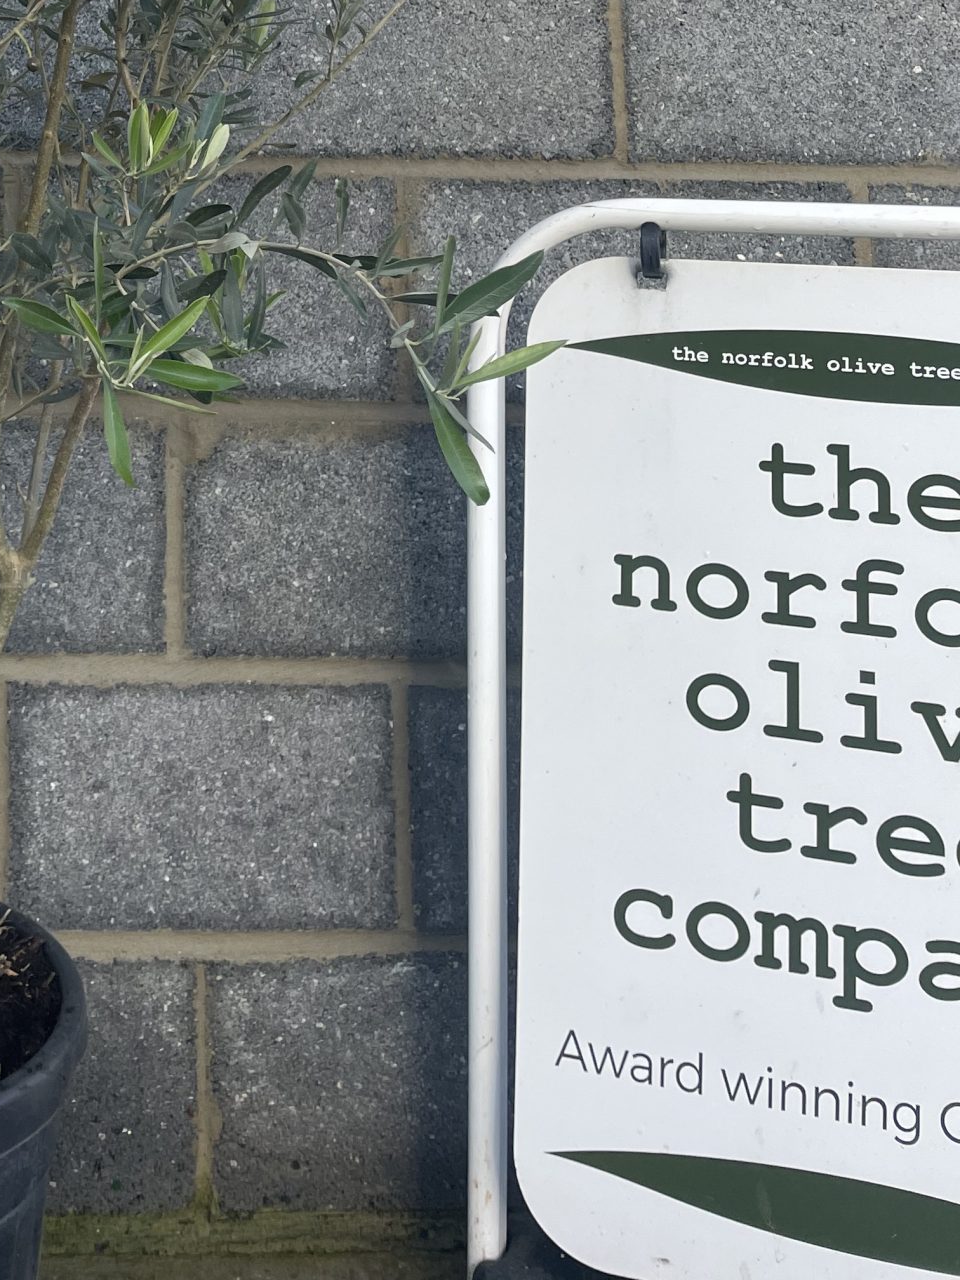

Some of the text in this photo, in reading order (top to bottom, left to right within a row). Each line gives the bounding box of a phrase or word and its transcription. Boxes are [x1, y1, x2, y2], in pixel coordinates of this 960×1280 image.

[671, 346, 960, 380] the norfolk olive tree
[758, 442, 960, 533] the
[611, 553, 960, 648] norfo
[685, 659, 960, 763] oliv
[726, 772, 960, 878] tre
[613, 888, 960, 1013] compa
[555, 1029, 704, 1095] Award
[720, 1066, 921, 1146] winning
